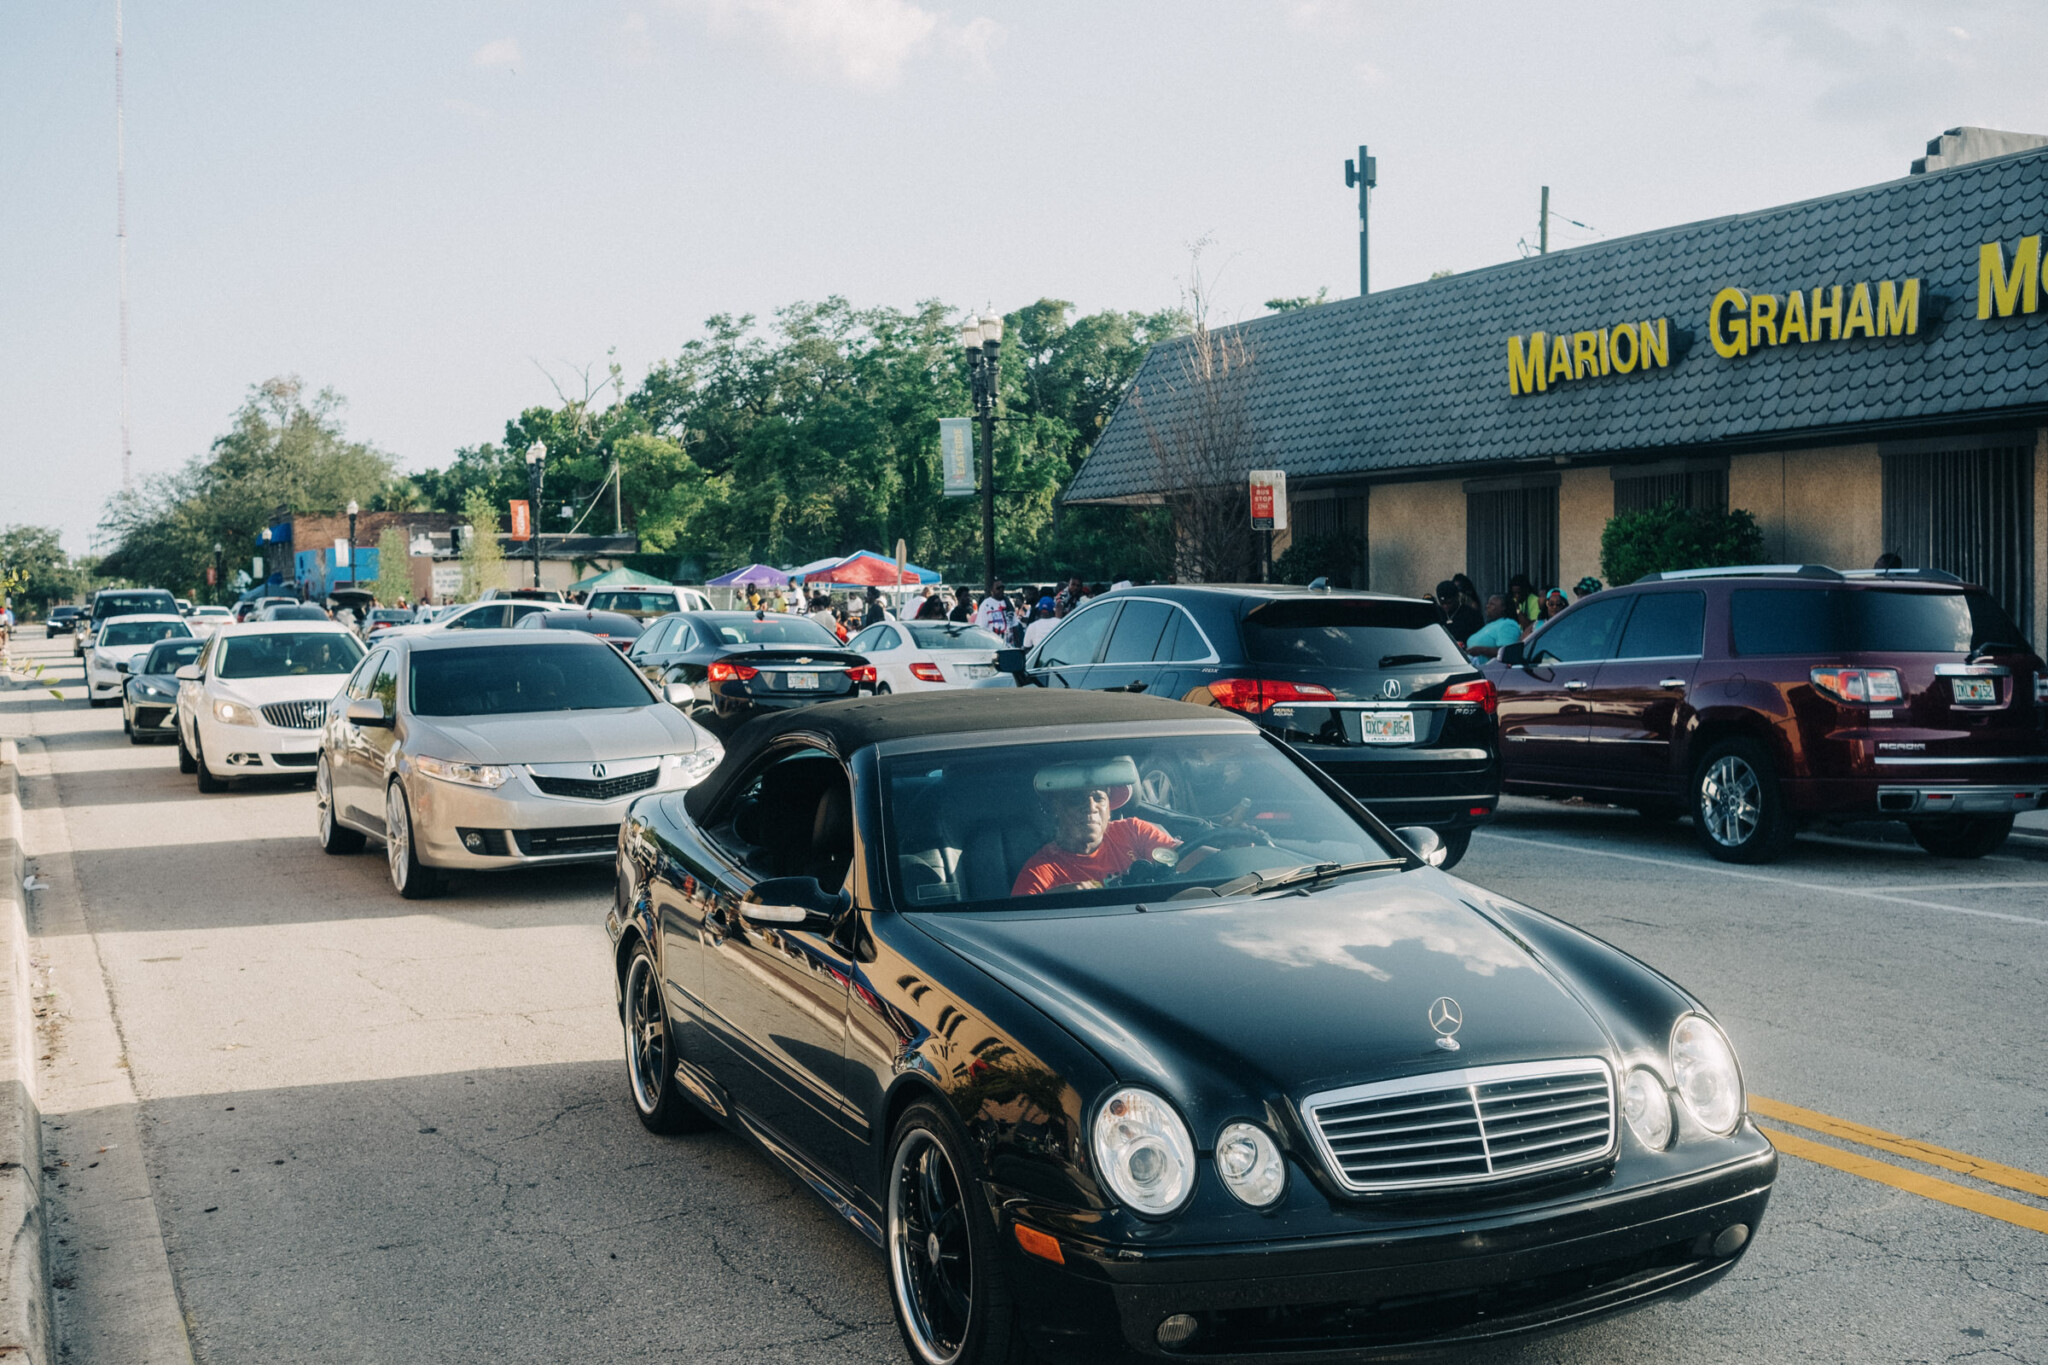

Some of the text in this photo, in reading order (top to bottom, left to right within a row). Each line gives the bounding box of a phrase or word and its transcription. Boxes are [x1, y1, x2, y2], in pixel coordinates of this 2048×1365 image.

[1508, 234, 2048, 396] MARION GRAHAM M
